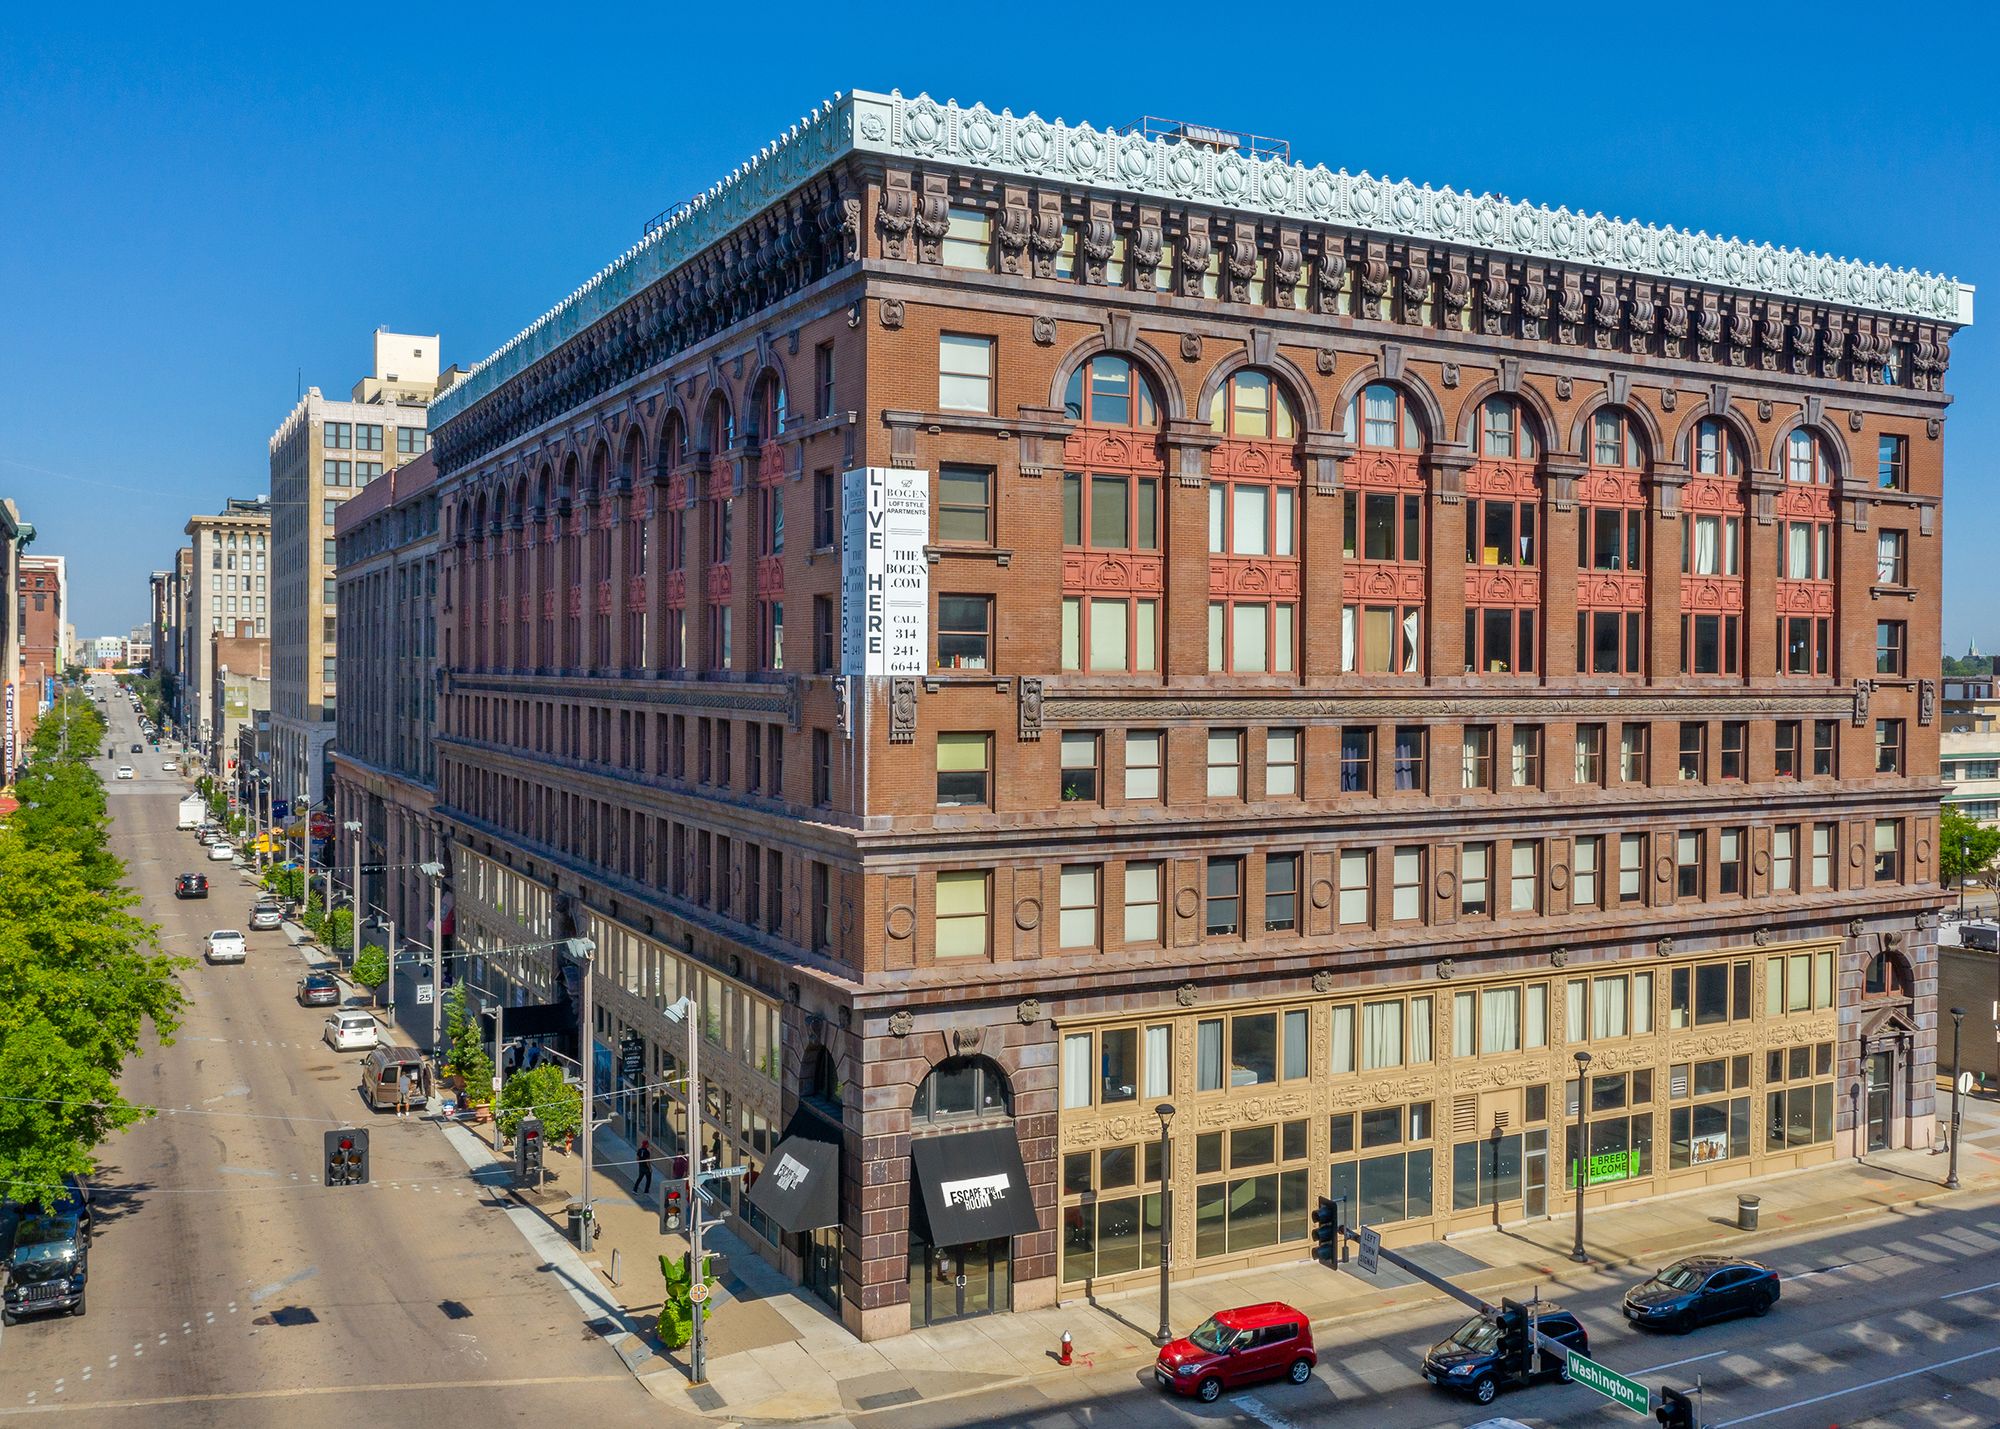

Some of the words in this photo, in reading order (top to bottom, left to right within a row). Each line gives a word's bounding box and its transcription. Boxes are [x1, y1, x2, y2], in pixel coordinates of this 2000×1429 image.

[887, 489, 927, 498] BOGEN
[868, 469, 883, 549] LIVE
[893, 550, 919, 561] THE
[886, 564, 927, 575] BOGEN
[890, 578, 920, 588] .COM
[868, 574, 882, 653] HERE
[893, 615, 920, 624] CALL
[895, 629, 916, 639] 314
[891, 661, 920, 671] 6644
[1598, 1152, 1632, 1166] BREED
[1584, 1162, 1627, 1176] ELCOME
[950, 1187, 981, 1205] ESCAPE
[964, 1193, 992, 1211] ROOM
[1365, 1232, 1376, 1244] LEFT
[1363, 1243, 1375, 1256] TURN
[1360, 1254, 1376, 1269] SIGNAL
[1570, 1356, 1634, 1402] Washington
[1636, 1393, 1646, 1405] Ave
